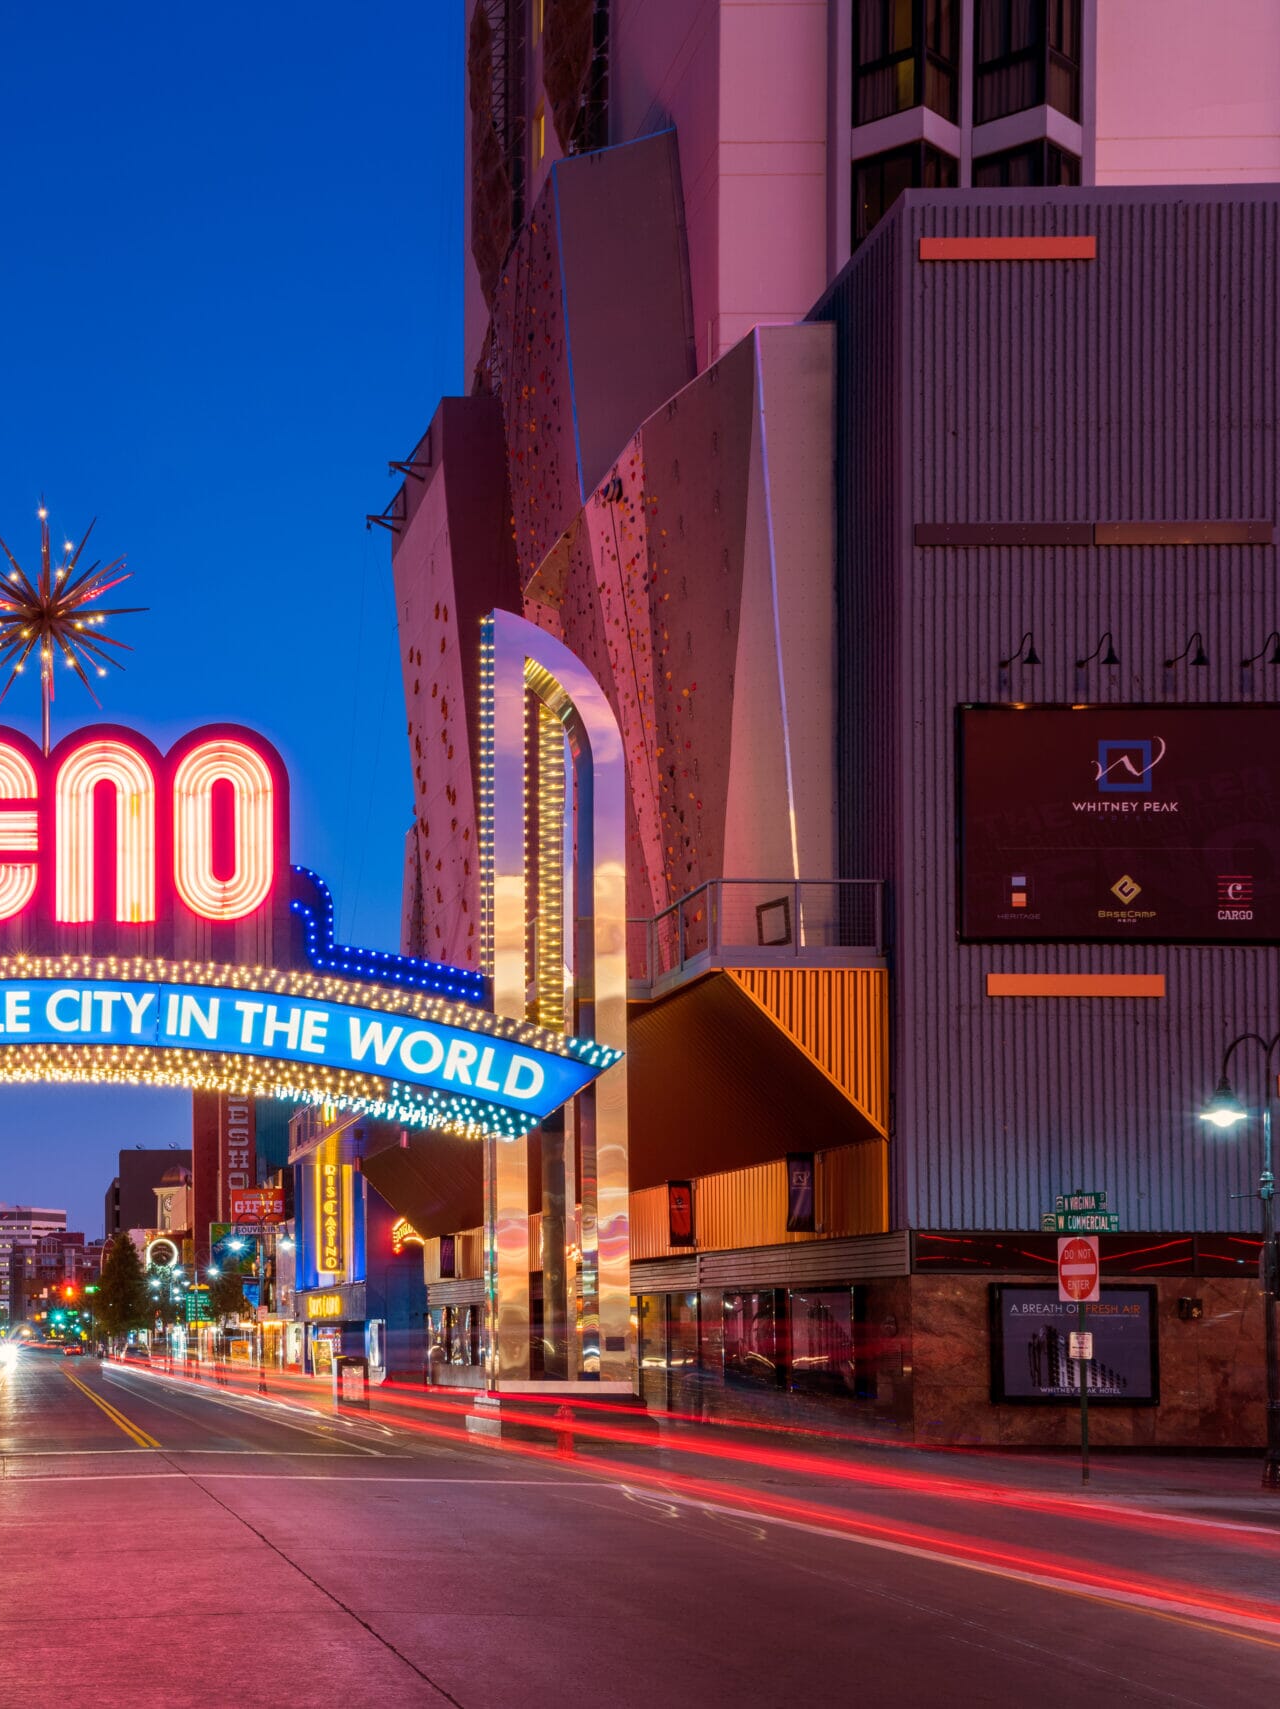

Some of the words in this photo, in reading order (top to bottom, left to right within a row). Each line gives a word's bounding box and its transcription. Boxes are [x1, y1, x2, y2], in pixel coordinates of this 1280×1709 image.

[1072, 801, 1138, 812] WHITNEY
[1143, 801, 1179, 812] PEAK
[1217, 910, 1253, 920] CARGO
[45, 989, 157, 1033] CITY
[165, 994, 219, 1040] IN
[234, 1001, 329, 1055] THE
[348, 1014, 545, 1100] WORLD
[234, 1199, 284, 1214] GIFTS
[1070, 1195, 1096, 1210] VIRGINIA
[1057, 1215, 1065, 1229] W
[1067, 1215, 1110, 1230] COMMERCIAL
[323, 1200, 337, 1269] CASINO
[1064, 1249, 1074, 1260] DO
[1078, 1248, 1091, 1260] NOT
[1067, 1279, 1090, 1290] ENTER
[1010, 1304, 1019, 1314] A
[1022, 1303, 1063, 1314] BREATH
[1085, 1304, 1118, 1315] FRESH
[1122, 1304, 1141, 1315] AIR
[1039, 1386, 1075, 1394] WHITNEY
[1099, 1387, 1121, 1395] HOTEL
